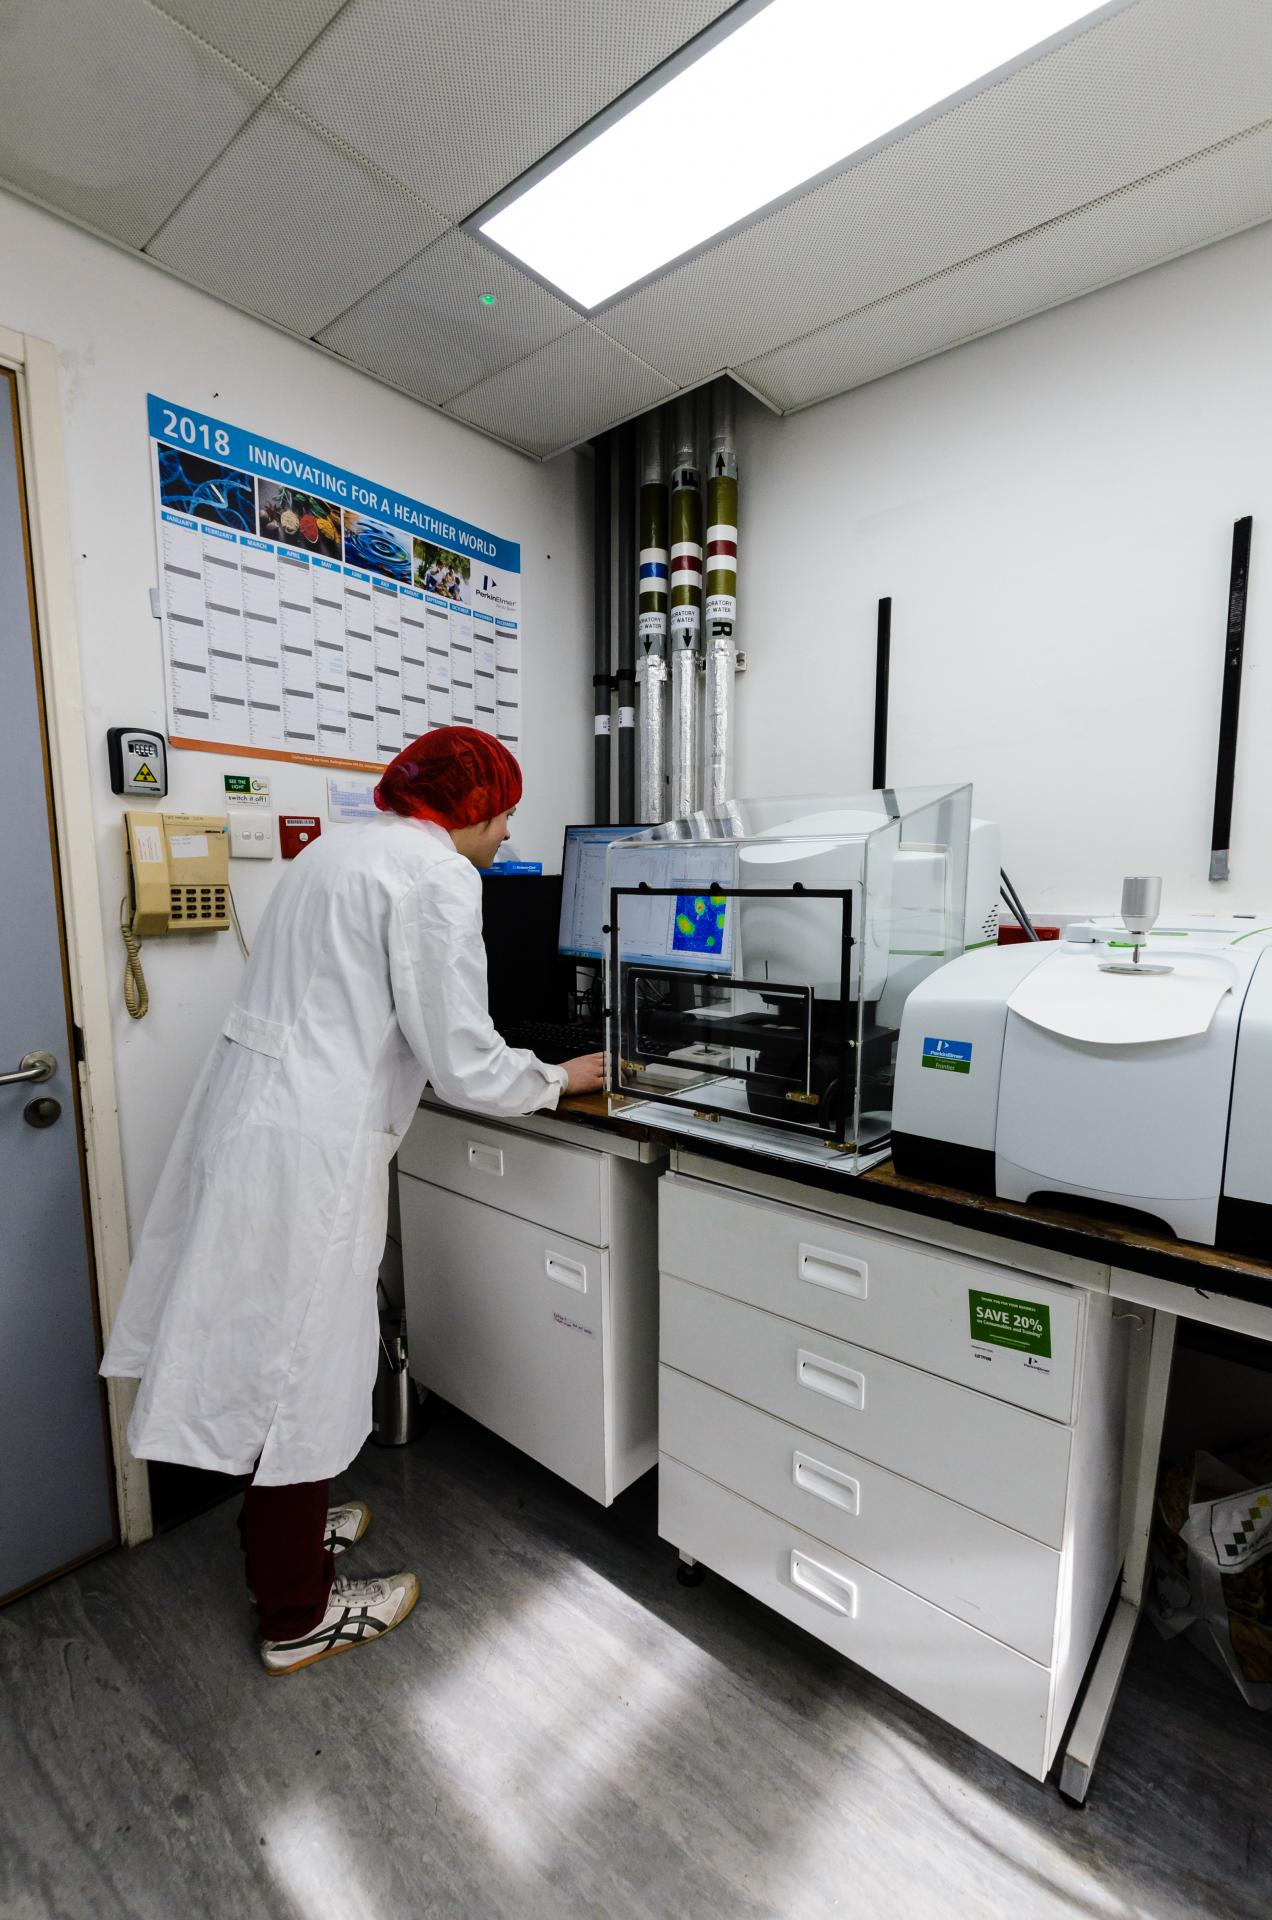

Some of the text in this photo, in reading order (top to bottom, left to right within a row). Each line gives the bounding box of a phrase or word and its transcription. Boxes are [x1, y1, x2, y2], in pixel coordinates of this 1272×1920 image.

[163, 409, 231, 456] 2018
[248, 445, 497, 558] INNOVATING FOR A HEALTHIER WORLD
[166, 514, 193, 528] JANUARY
[205, 527, 233, 540] FEBRUARY
[247, 540, 267, 550] MARCH
[286, 551, 300, 559] APRIL
[321, 560, 332, 569] MAY
[403, 589, 420, 598] AUGUST
[476, 589, 516, 607] PerkinElmer
[976, 1306, 1043, 1332] SAVE 20%
